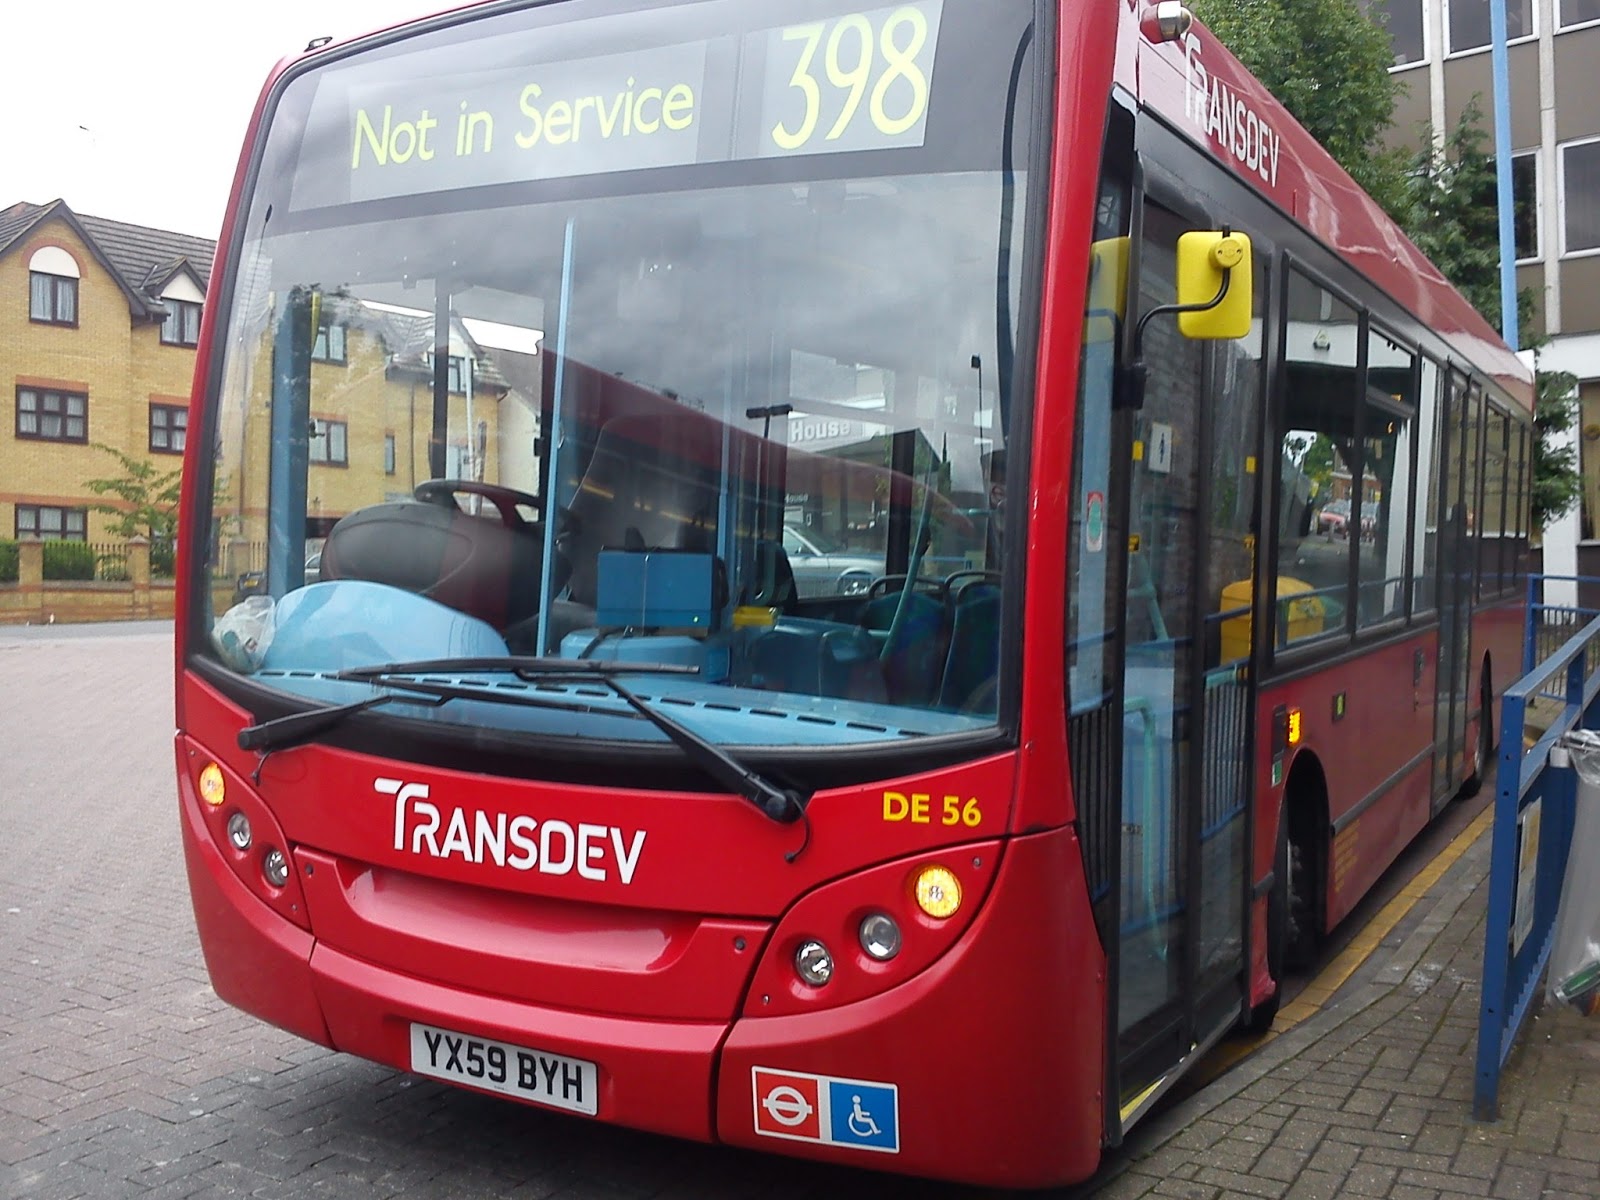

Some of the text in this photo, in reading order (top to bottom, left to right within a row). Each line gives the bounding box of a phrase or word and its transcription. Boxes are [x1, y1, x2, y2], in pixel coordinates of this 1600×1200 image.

[351, 76, 695, 169] Not in Service
[772, 6, 928, 150] 398
[1180, 32, 1280, 188] TRANSDEV
[791, 420, 851, 442] House
[374, 777, 647, 884] TRANSDEV
[883, 791, 982, 827] DE 56
[424, 1030, 583, 1102] YX59 BYH
